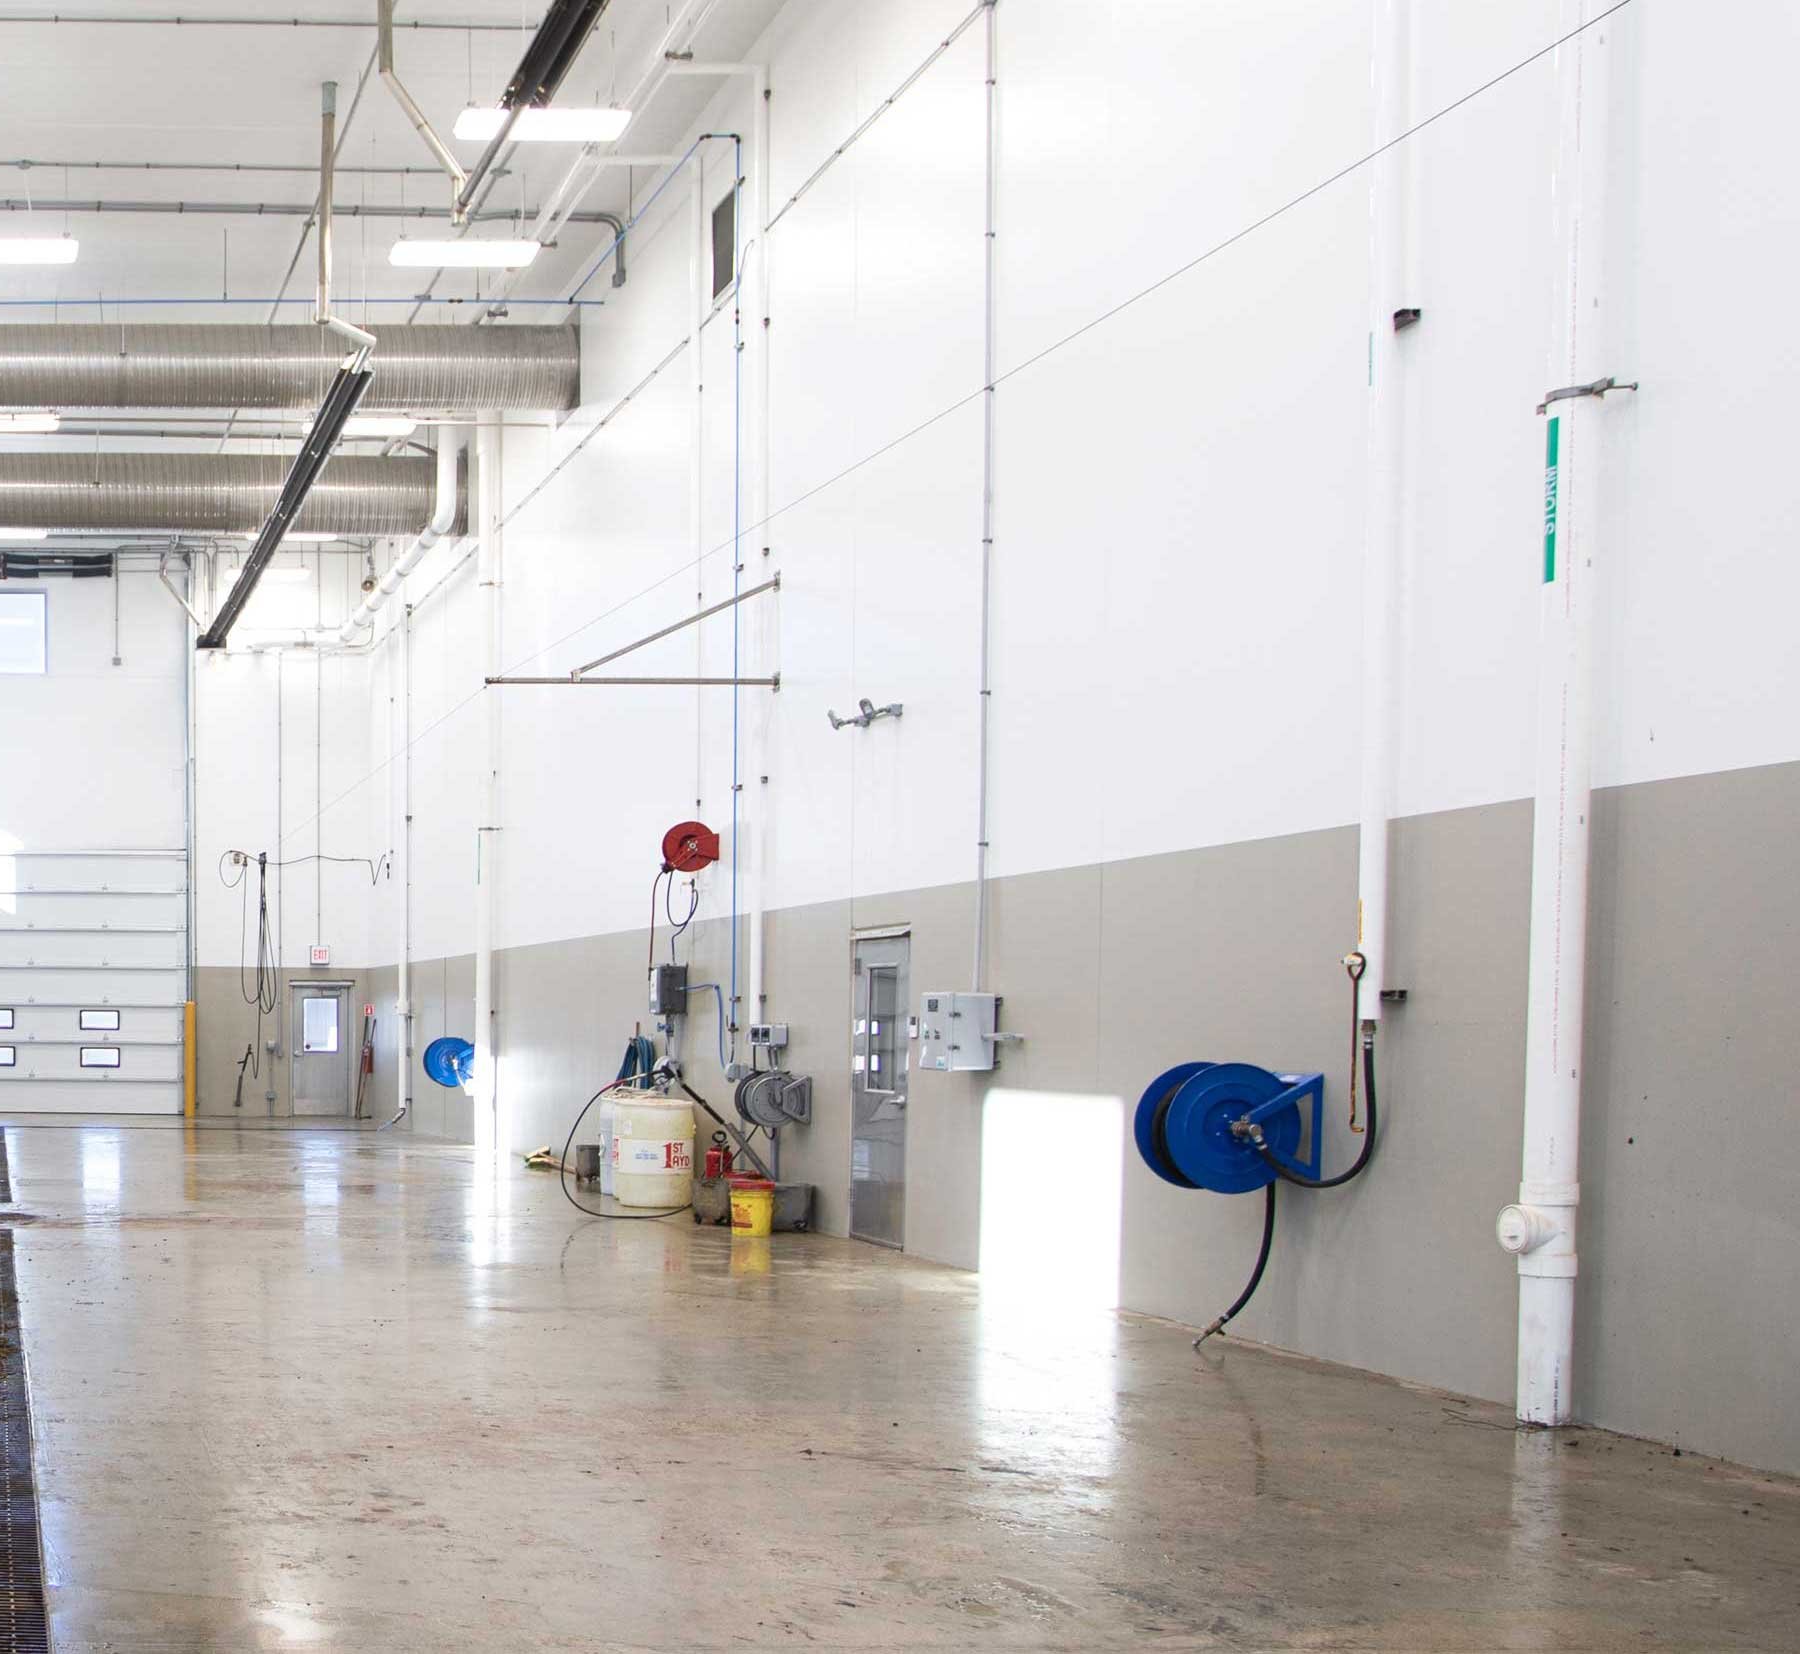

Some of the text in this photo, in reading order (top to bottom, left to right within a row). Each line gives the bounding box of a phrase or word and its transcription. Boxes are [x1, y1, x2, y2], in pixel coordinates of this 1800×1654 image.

[1545, 466, 1557, 534] STORM
[313, 949, 327, 960] EXIT
[672, 1155, 690, 1167] AYD
